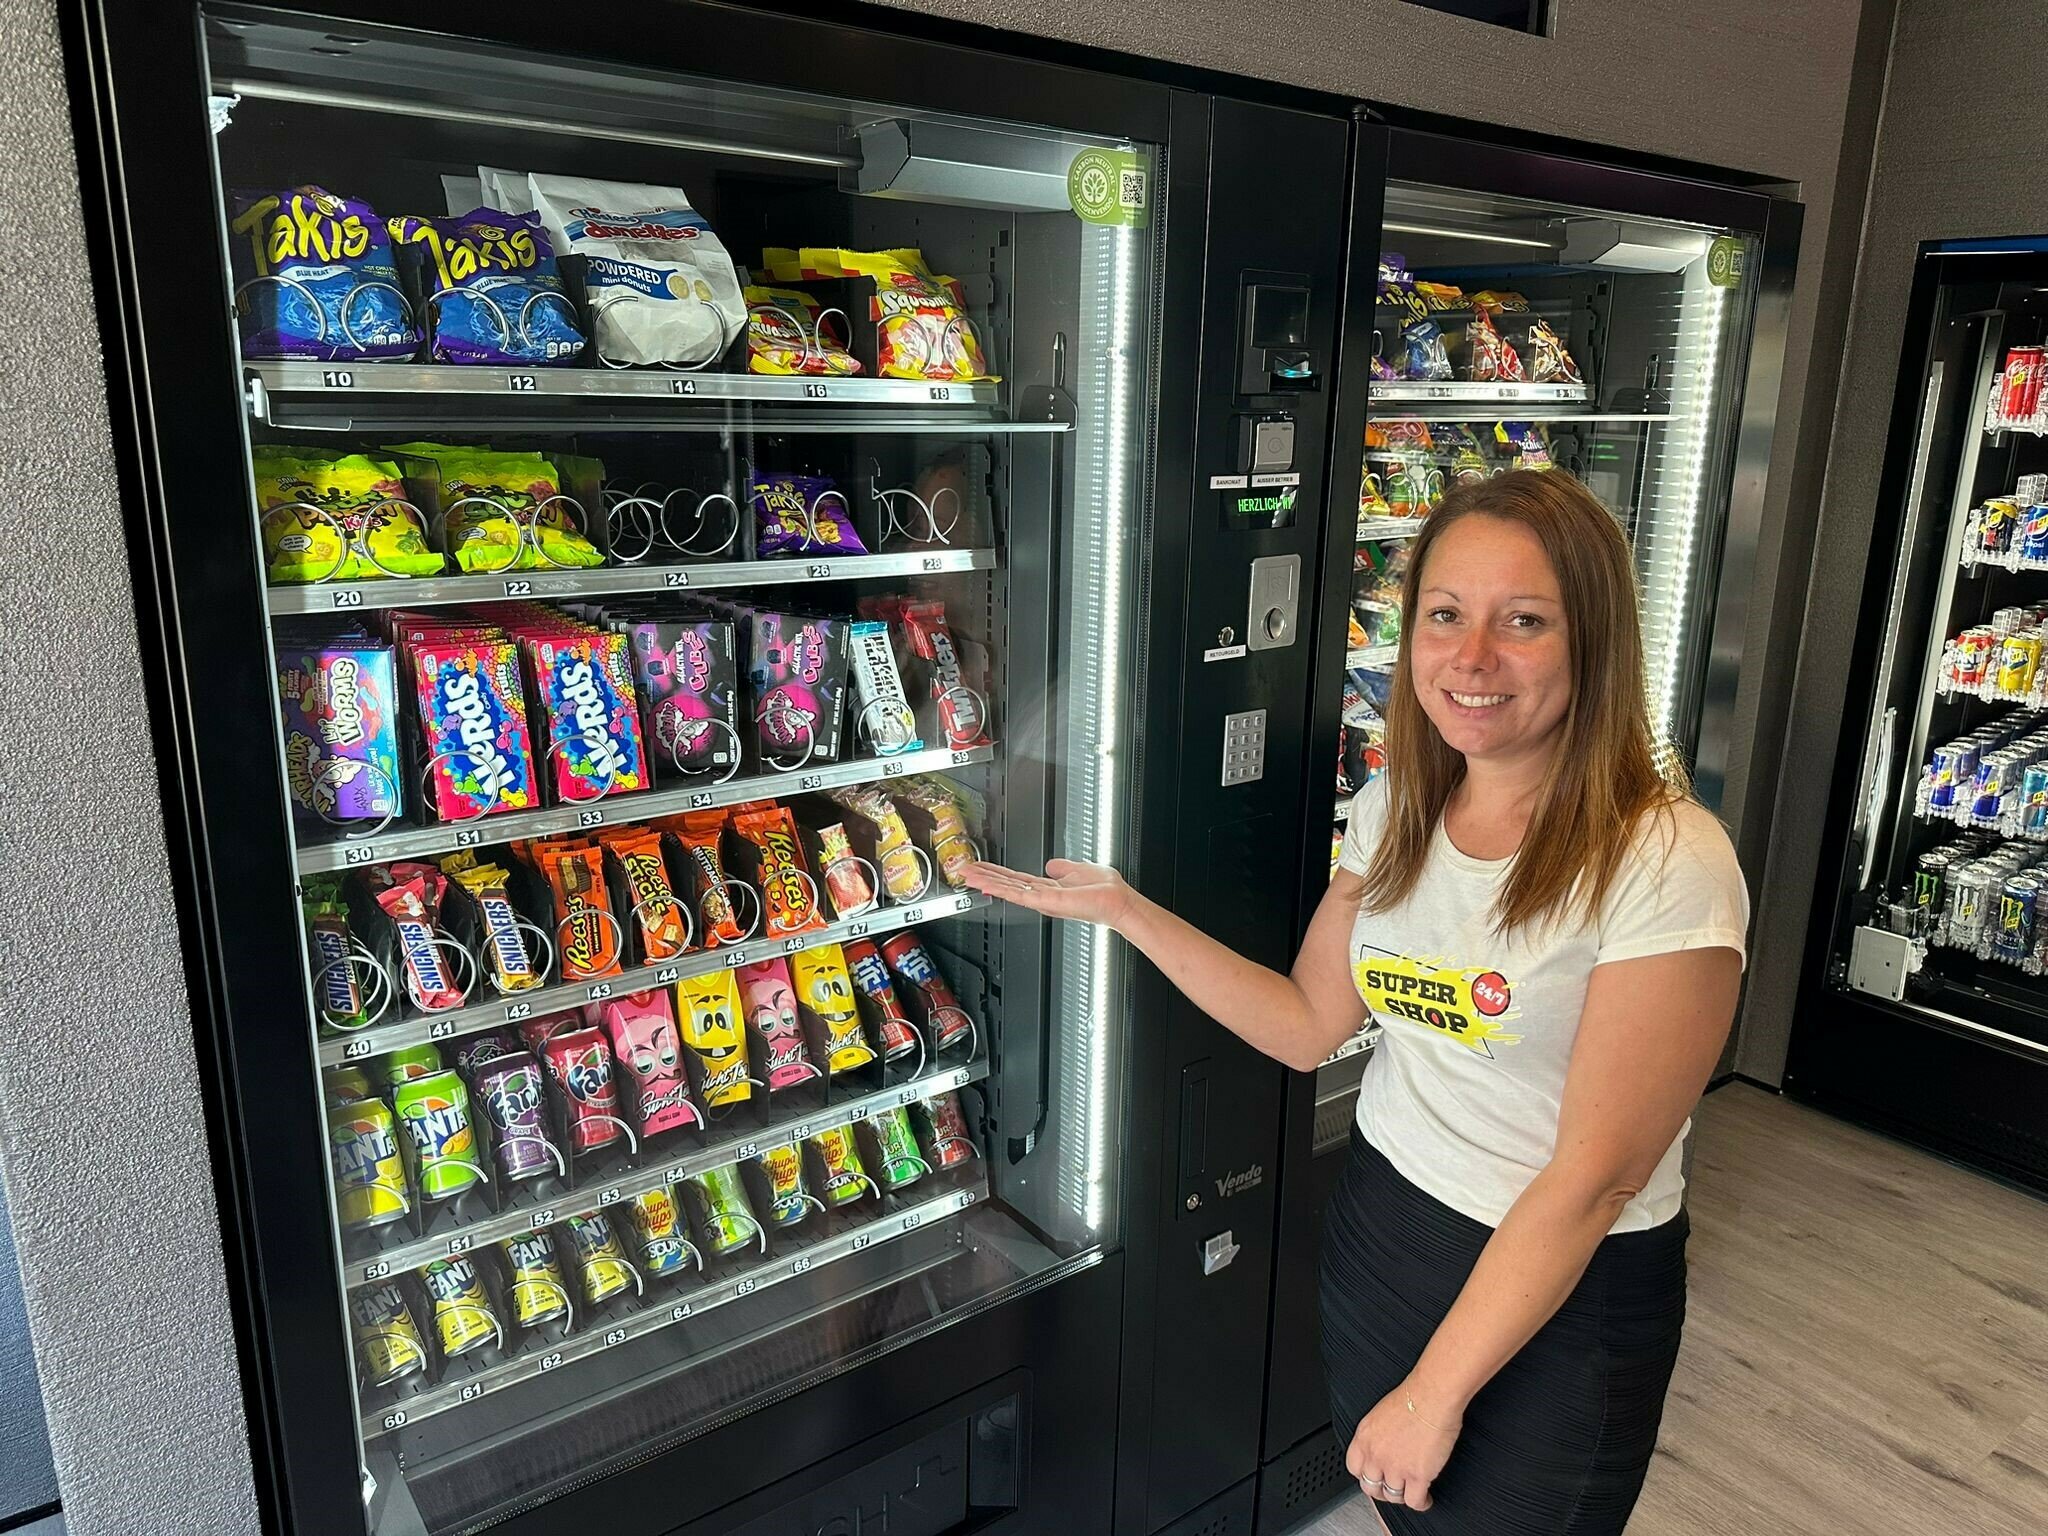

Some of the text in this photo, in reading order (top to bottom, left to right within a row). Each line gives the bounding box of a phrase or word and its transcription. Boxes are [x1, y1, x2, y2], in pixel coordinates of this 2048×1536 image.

[1074, 156, 1116, 185] CARBON NEUTRAL
[232, 195, 369, 276] Takis
[584, 220, 698, 240] donettes
[410, 225, 538, 290] Takis
[295, 269, 329, 277] BLUE HEAT
[588, 259, 661, 285] POWDERED
[602, 276, 652, 293] mini donuts
[326, 372, 351, 387] 10
[512, 376, 535, 391] 12
[675, 380, 695, 394] 14
[809, 385, 826, 398] 16
[932, 388, 948, 400] 18
[1237, 497, 1278, 513] HERZLICH
[926, 558, 942, 569] 28
[812, 565, 829, 577] 26
[668, 573, 688, 586] 24
[509, 582, 531, 595] 22
[336, 592, 361, 607] 20
[792, 645, 802, 675] GALACTIC
[802, 625, 823, 683] CUBES
[1209, 648, 1240, 658] RETOURGELD
[675, 652, 686, 684] GALACTIC
[682, 631, 709, 692] CUBES
[608, 652, 624, 687] fruits
[495, 663, 513, 699] fruits
[332, 660, 361, 742] WORMS
[954, 752, 968, 763] 39
[887, 763, 902, 774] 38
[804, 776, 820, 788] 36
[693, 794, 712, 806] 34
[582, 812, 603, 824] 33
[459, 832, 480, 845] 31
[348, 849, 372, 862] 30
[764, 830, 809, 912] Reese's
[957, 897, 972, 908] 49
[906, 910, 921, 921] 48
[565, 895, 593, 970] Reese's
[851, 922, 868, 934] 47
[484, 900, 526, 972] SNICKERS
[786, 938, 803, 950] 46
[400, 923, 444, 990] SNICKERS
[726, 953, 744, 965] 45
[317, 932, 353, 1012] SNICKERS
[659, 969, 678, 980] 44
[591, 985, 611, 997] 43
[1365, 969, 1458, 1006] SUPER
[1475, 982, 1506, 1007] 24/7
[509, 1004, 530, 1017] 42
[1384, 997, 1469, 1034] SHOP
[433, 1023, 453, 1036] 41
[346, 1041, 370, 1054] 40
[956, 1071, 970, 1083] 59
[902, 1089, 917, 1101] 58
[852, 1107, 868, 1119] 57
[793, 1126, 810, 1138] 56
[740, 1144, 757, 1157] 55
[765, 1153, 796, 1171] Chupa
[667, 1167, 685, 1181] 54
[1215, 1164, 1263, 1197] Vendo
[601, 1190, 620, 1203] 53
[961, 1193, 975, 1205] 69
[636, 1199, 669, 1217] Chupa
[533, 1211, 553, 1226] 52
[637, 1210, 672, 1232] Chups
[904, 1216, 920, 1227] 68
[451, 1237, 472, 1251] 51
[853, 1234, 870, 1247] 67
[367, 1263, 388, 1278] 50
[794, 1259, 810, 1271] 66
[738, 1281, 755, 1293] 65
[673, 1305, 692, 1319] 64
[607, 1330, 626, 1344] 63
[542, 1354, 562, 1368] 62
[462, 1384, 482, 1399] 61
[384, 1412, 406, 1428] 60
